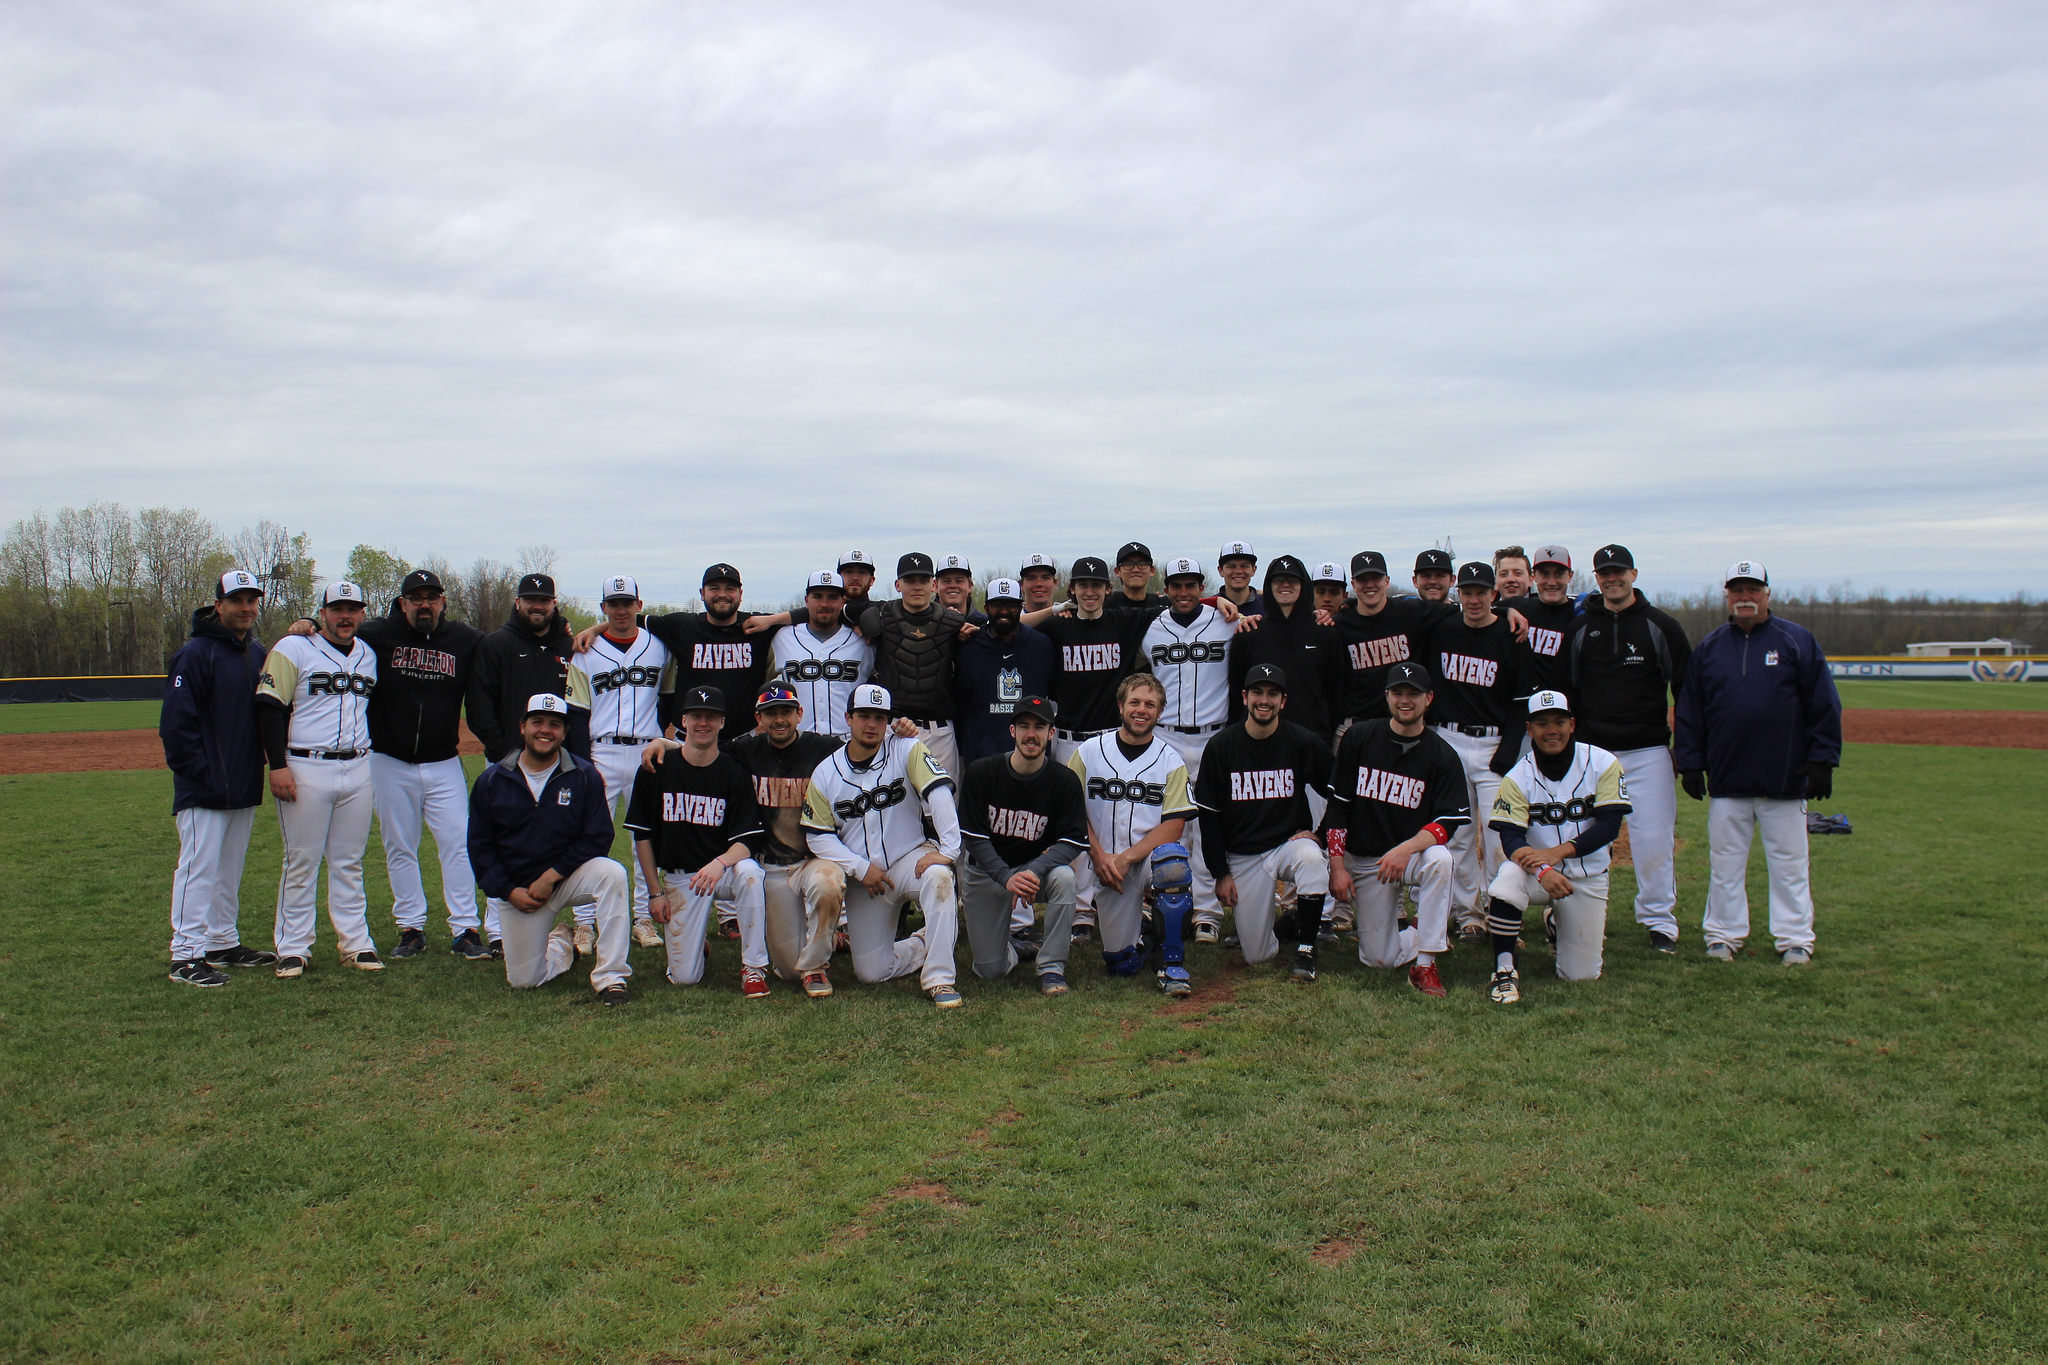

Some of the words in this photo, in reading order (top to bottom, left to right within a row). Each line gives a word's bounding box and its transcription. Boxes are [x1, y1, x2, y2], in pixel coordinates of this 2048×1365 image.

[692, 642, 753, 670] RAVENS
[1062, 642, 1121, 672] RAVENS
[1151, 640, 1227, 666] ROOS
[1347, 633, 1410, 670] RAVENS
[1528, 626, 1564, 657] AVEN
[391, 646, 456, 678] CARLETON
[784, 659, 862, 683] ROOS
[1440, 652, 1499, 688] RAVENS
[1831, 664, 1893, 675] TON
[174, 675, 182, 688] 6
[309, 671, 376, 698] ROOS
[591, 665, 661, 696] ROOS
[834, 777, 907, 821] ROOS
[1087, 776, 1167, 806] ROOS
[1231, 768, 1295, 801] RAVENS
[1356, 765, 1426, 809] RAVENS
[662, 792, 726, 827] RAVENS
[987, 804, 1049, 841] RAVENS
